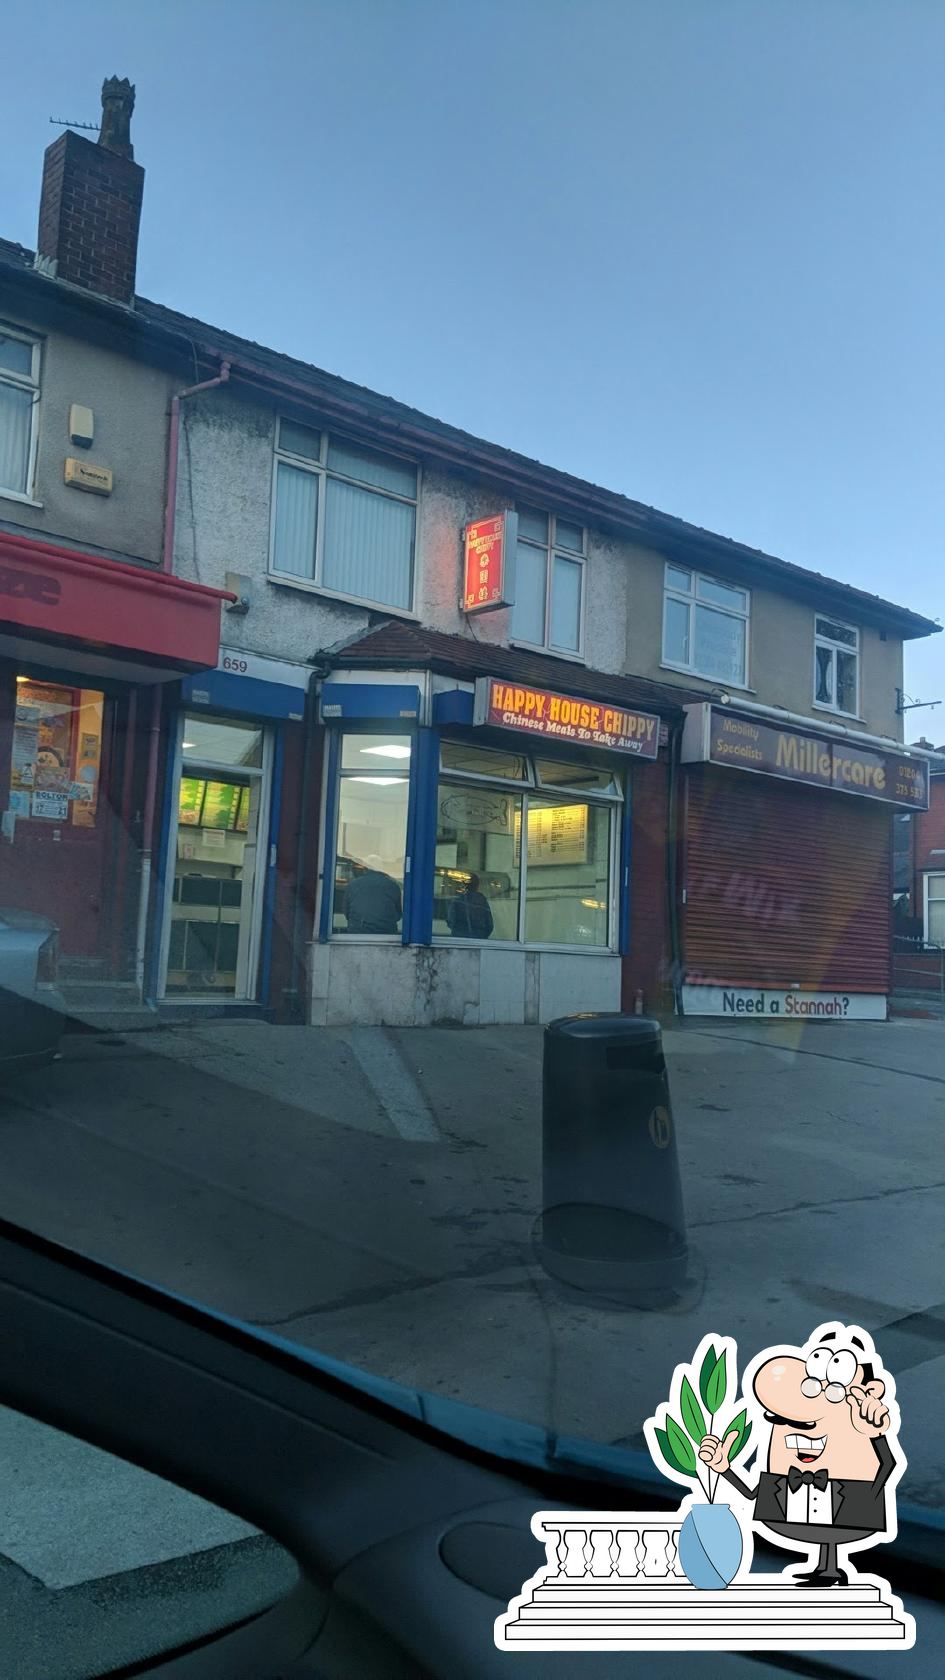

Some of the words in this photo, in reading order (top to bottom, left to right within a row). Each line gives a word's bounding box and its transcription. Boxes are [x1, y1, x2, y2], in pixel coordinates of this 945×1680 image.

[222, 656, 248, 673] 659
[492, 684, 545, 717] HAPPY
[550, 697, 600, 730] HOUSE
[603, 710, 655, 741] CHIPPY
[502, 711, 544, 731] Chinese
[545, 720, 576, 738] Meals
[577, 727, 591, 740] To
[592, 731, 616, 747] Take
[617, 737, 644, 753] Away
[723, 719, 760, 742] Mobility
[716, 739, 763, 761] Specialists
[775, 734, 886, 791] Millercare
[36, 791, 68, 800] BOLTON
[722, 991, 765, 1013] Need
[769, 998, 780, 1014] a
[784, 994, 850, 1016] Stannah?
